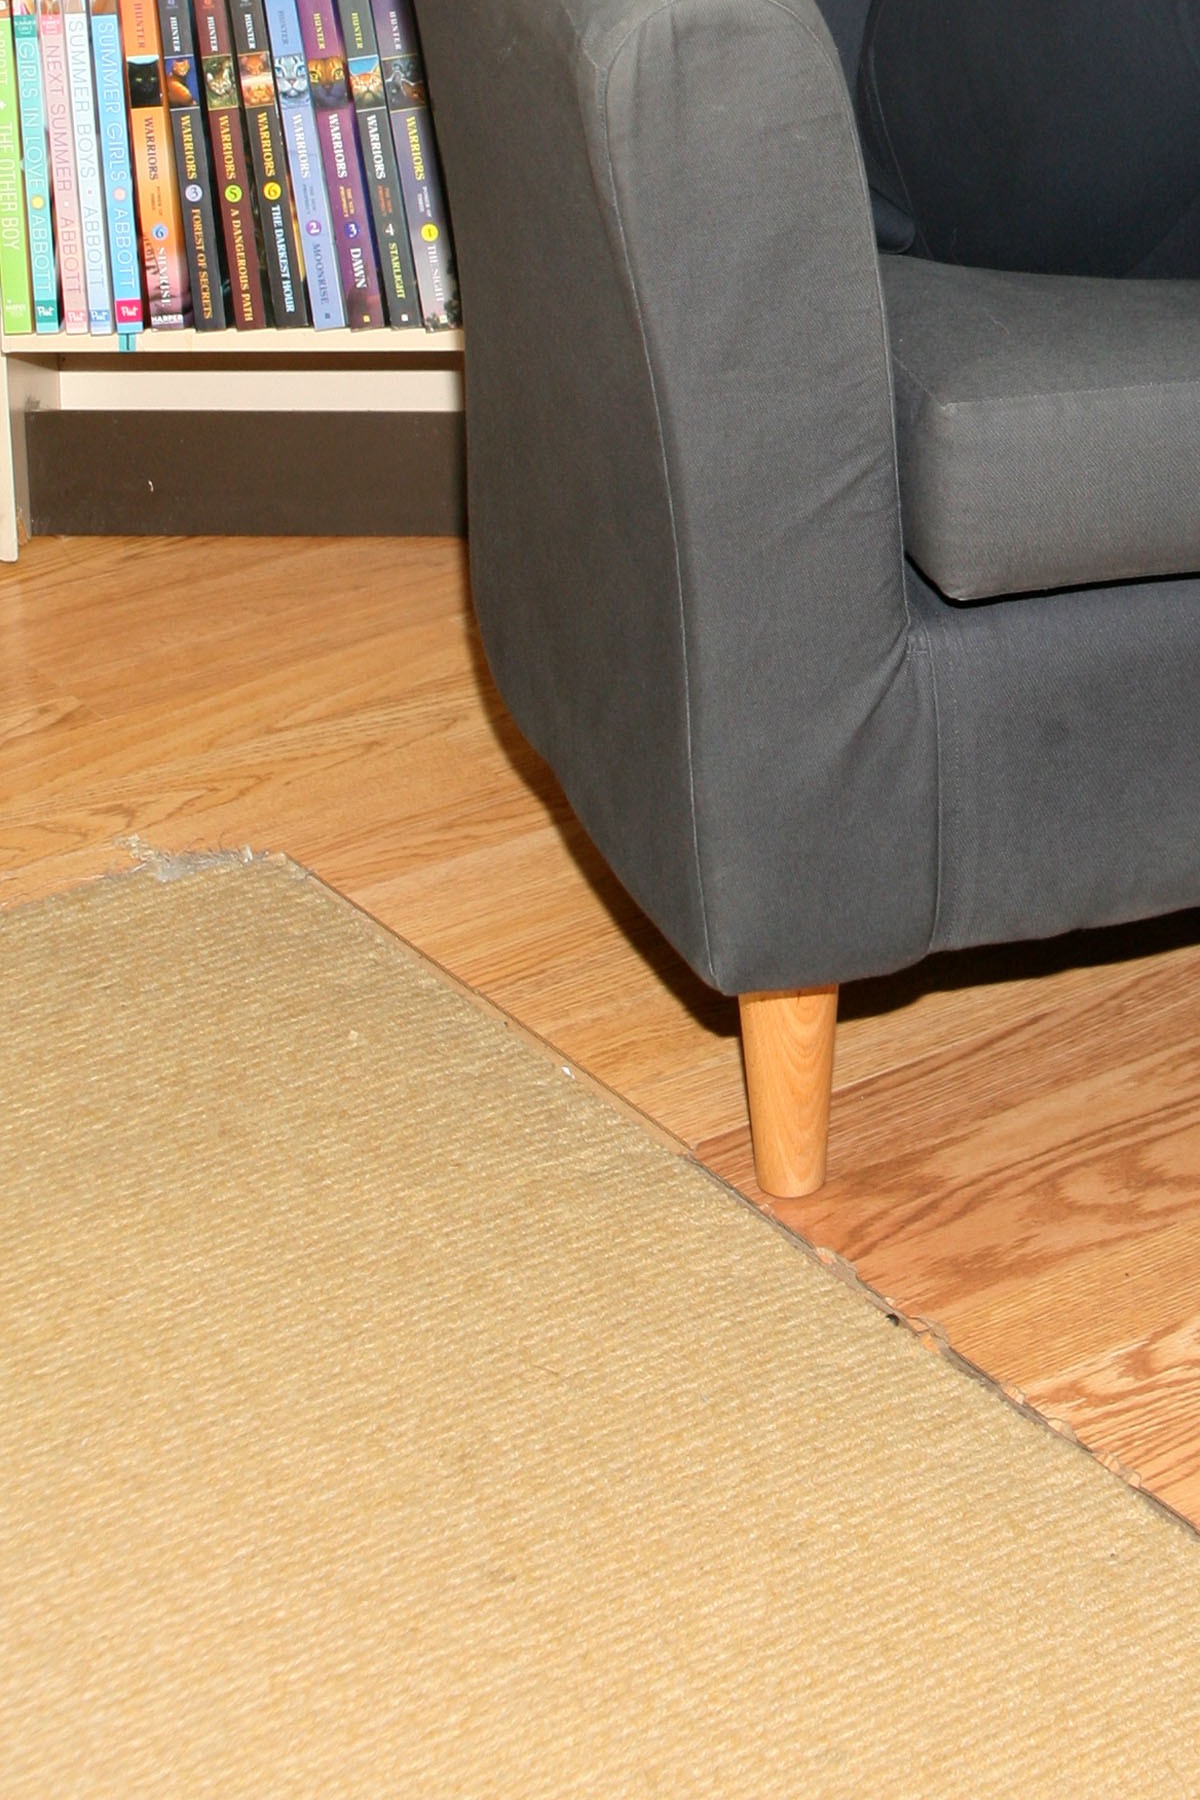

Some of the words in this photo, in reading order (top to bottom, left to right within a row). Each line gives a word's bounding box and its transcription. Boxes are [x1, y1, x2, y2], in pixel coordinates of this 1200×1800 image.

[133, 3, 146, 49] HUNTER
[169, 16, 181, 53] HUNTER
[206, 16, 219, 53] HUNTER
[243, 13, 257, 50] HUNTER
[313, 13, 325, 50] HUNTER
[351, 12, 364, 50] HUNTER
[389, 11, 402, 50] HUNTER
[97, 22, 121, 112] SUMMER
[106, 119, 127, 181] GIRLS
[143, 117, 160, 181] WARRIORS
[179, 114, 199, 181] WARRIORS
[217, 114, 237, 180] WARRIORS
[255, 111, 277, 178] WARRIORS
[292, 113, 311, 179] WARRIORS
[328, 113, 348, 179] WARRIORS
[366, 114, 386, 180] WARRIORS
[405, 116, 425, 181] WARRIORS
[190, 208, 204, 252] FOREST
[231, 208, 239, 217] A
[271, 205, 281, 227] THE
[113, 207, 135, 290] ABBOTT
[197, 254, 206, 270] OF
[232, 220, 247, 290] DANGEROUS
[273, 229, 288, 278] DARKEST
[350, 247, 367, 289] DAWN
[389, 242, 405, 299] STARLIGHT
[427, 245, 439, 268] THE
[199, 272, 213, 319] SECRETS
[282, 281, 295, 313] HOUR
[312, 242, 330, 306] MOONRISE
[432, 270, 445, 302] SIGHT
[242, 293, 253, 321] PATH
